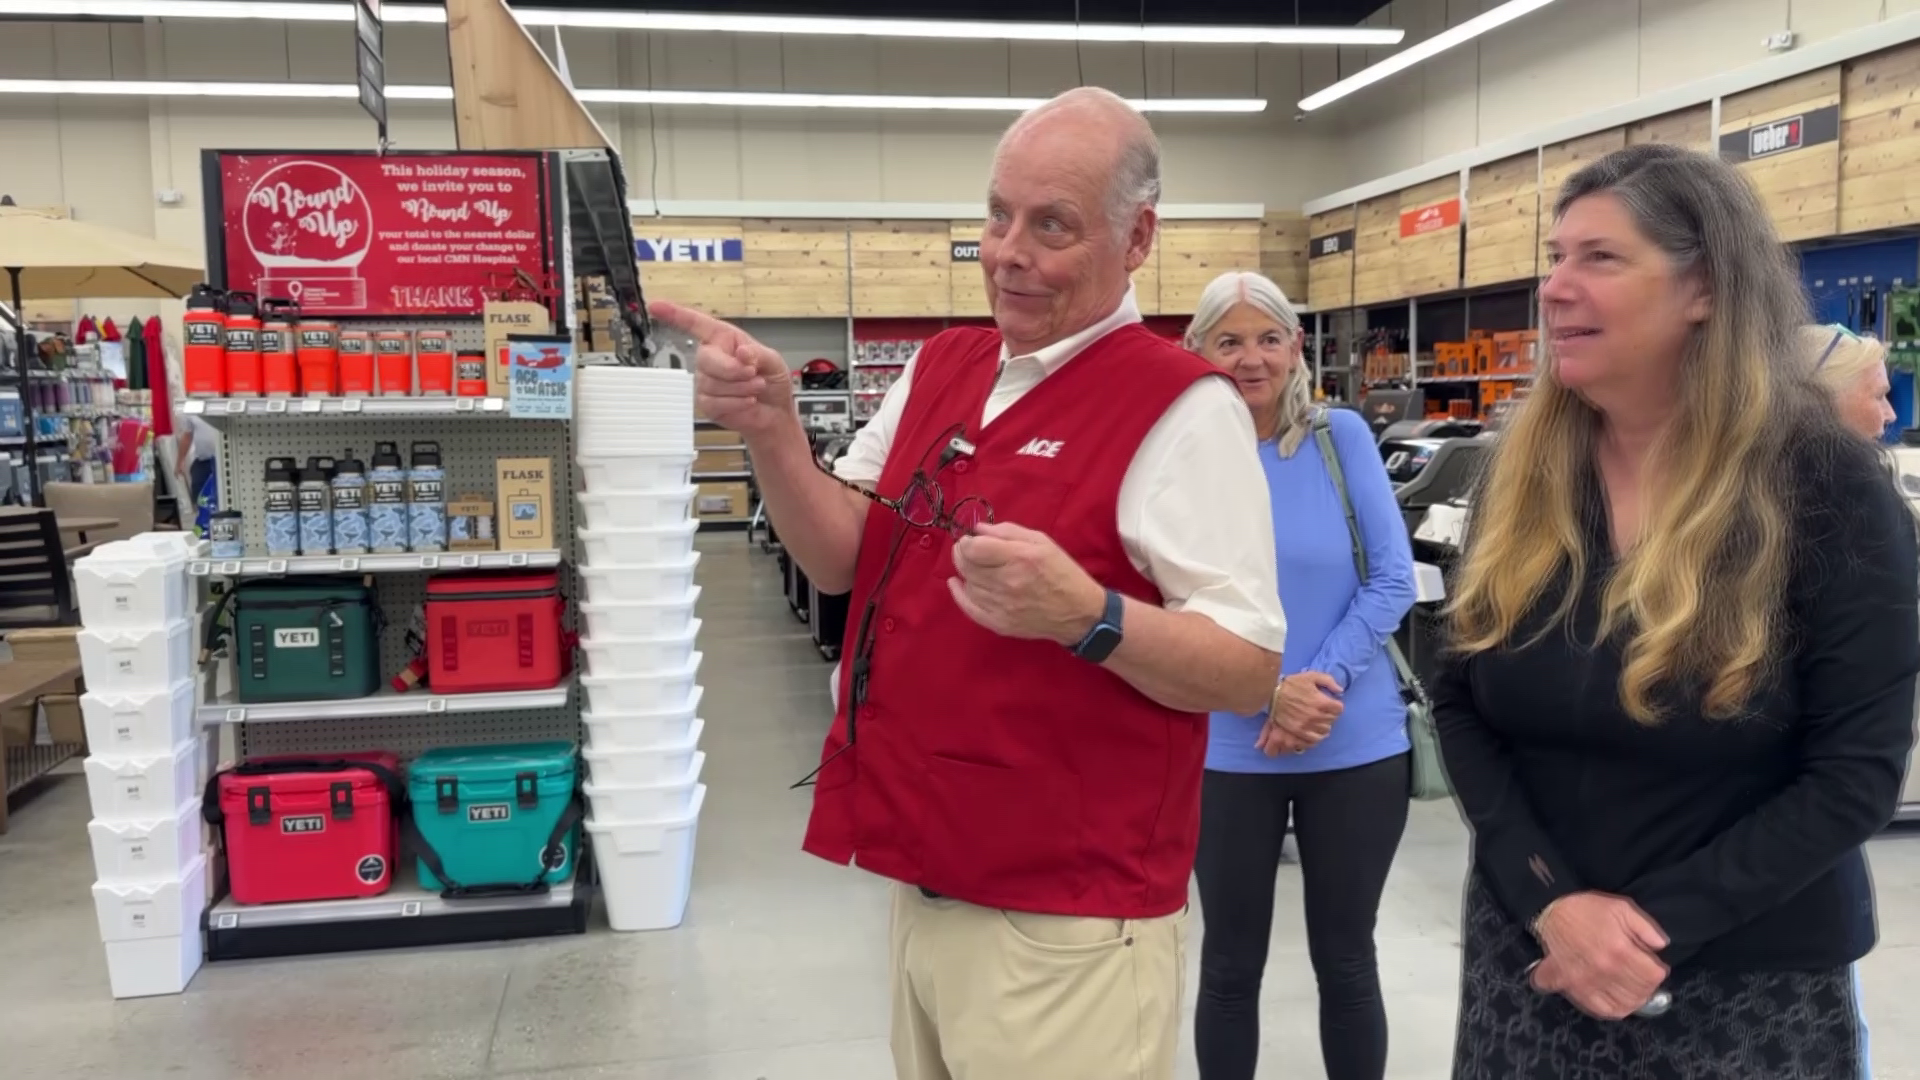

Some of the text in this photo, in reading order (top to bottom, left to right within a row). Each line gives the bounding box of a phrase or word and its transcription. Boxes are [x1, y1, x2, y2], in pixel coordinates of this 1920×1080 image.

[1753, 124, 1789, 154] weber
[381, 164, 526, 179] This holiday season,
[396, 180, 513, 195] we invite you to
[251, 176, 356, 219] Round
[401, 197, 513, 227] Round Up
[298, 209, 359, 249] Up
[378, 230, 535, 241] your total to the nearest dollar
[389, 242, 527, 253] and donate your change to
[648, 239, 723, 262] YETI
[397, 254, 519, 265] our local CMN Hospital.
[390, 285, 474, 308] THANK
[490, 314, 531, 323] FLASK
[188, 324, 218, 334] YETI
[227, 331, 254, 341] YETI
[262, 332, 278, 341] ETI
[303, 331, 329, 340] YETI
[1015, 437, 1066, 458] ACE
[502, 470, 544, 480] FLASK
[375, 482, 401, 492] YETI
[414, 482, 440, 492] YETI
[269, 491, 292, 500] YETI
[300, 491, 321, 500] YETI
[335, 488, 361, 498] YETI
[279, 632, 315, 643] YETI
[471, 806, 506, 819] YETI
[285, 818, 321, 831] YETI
